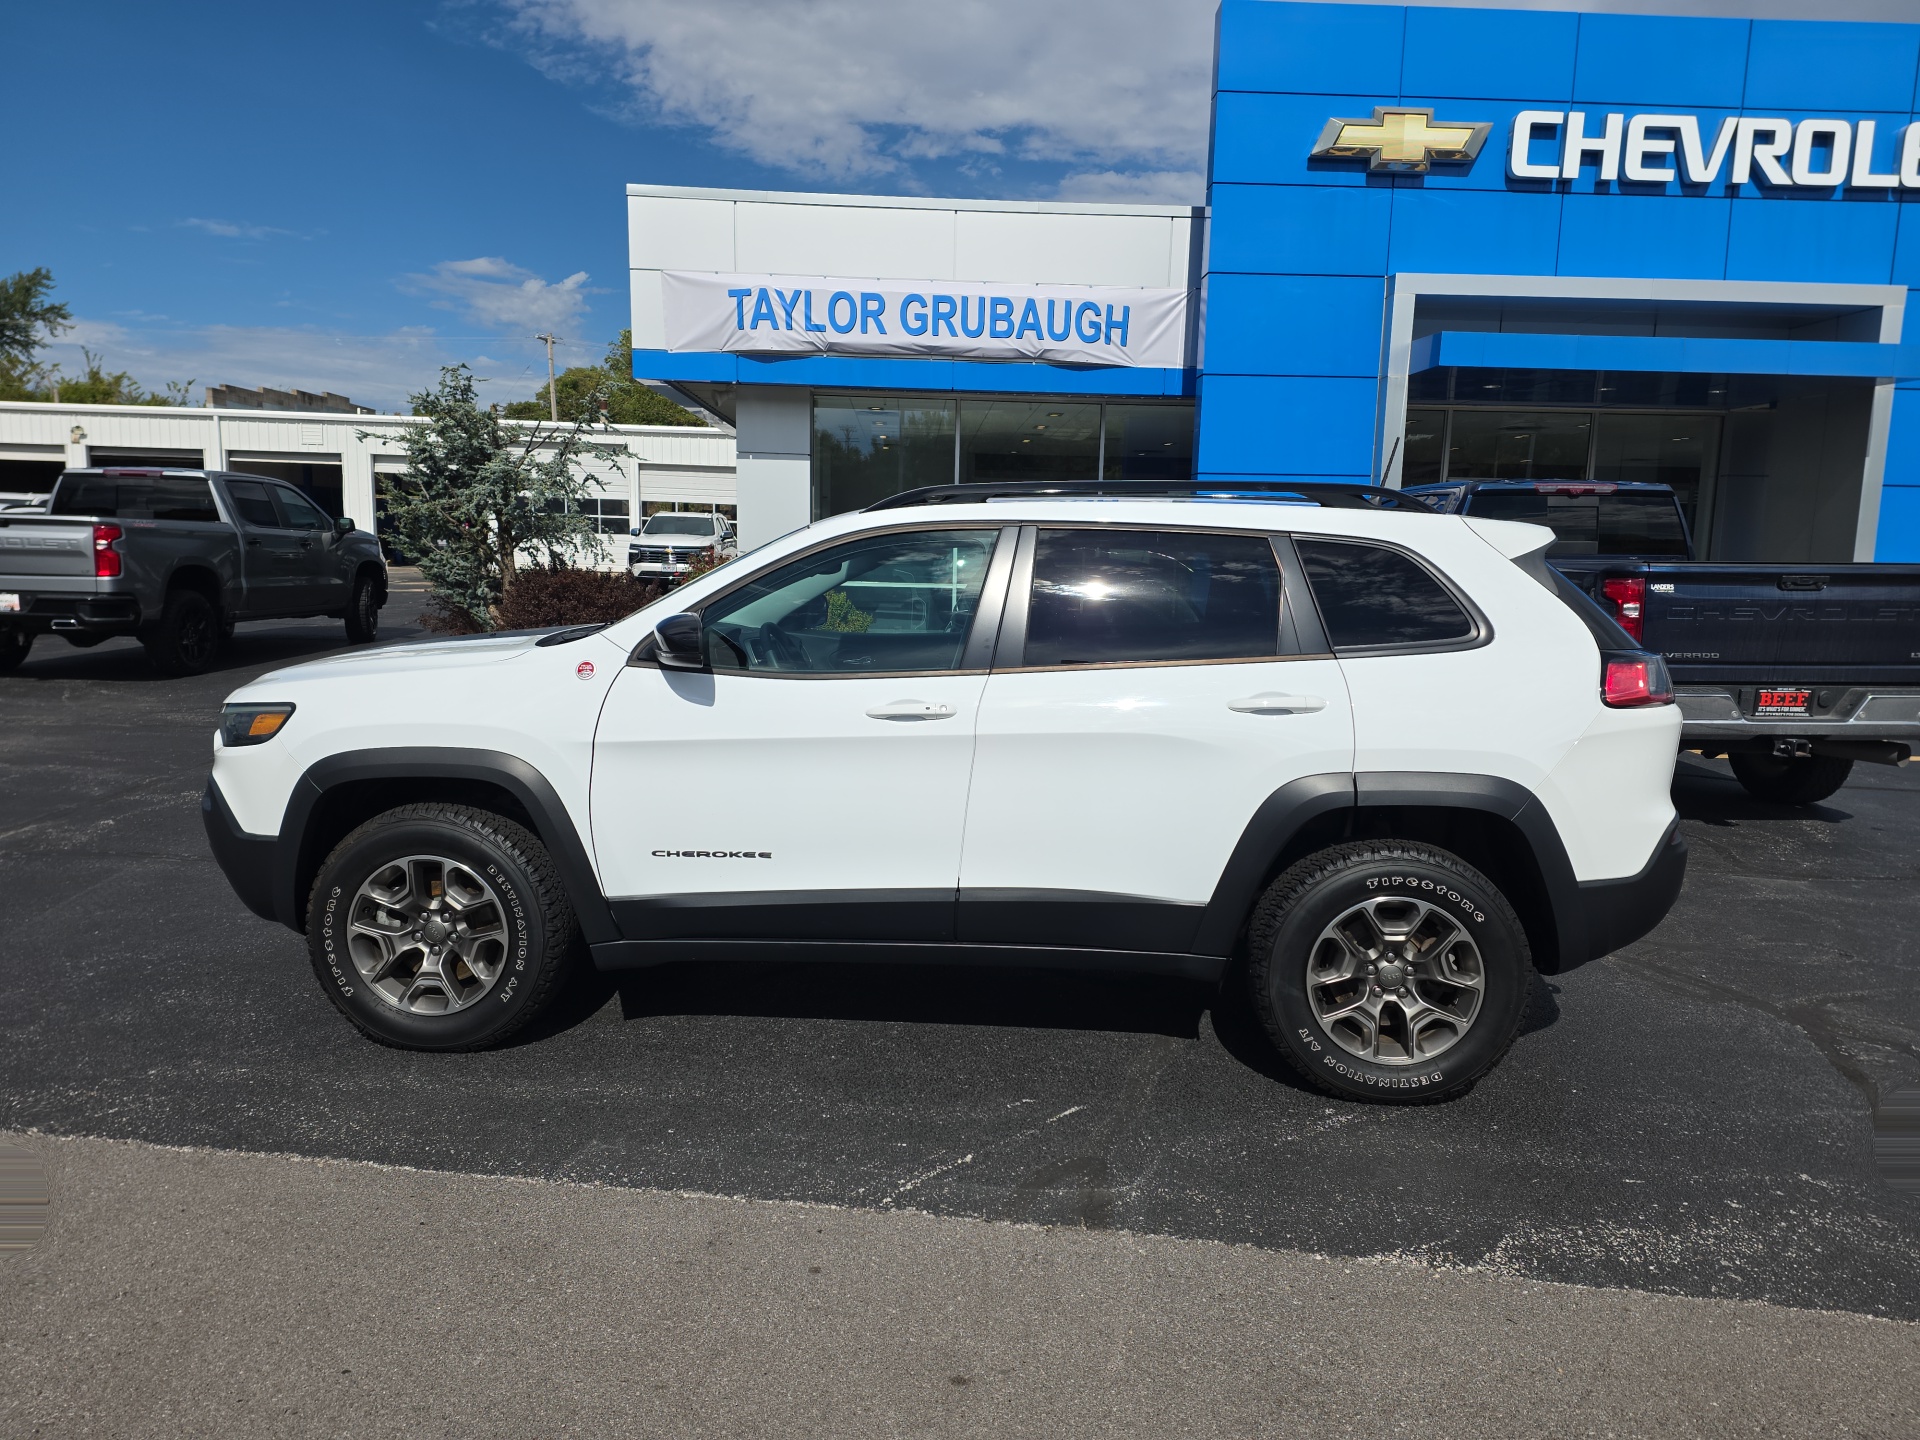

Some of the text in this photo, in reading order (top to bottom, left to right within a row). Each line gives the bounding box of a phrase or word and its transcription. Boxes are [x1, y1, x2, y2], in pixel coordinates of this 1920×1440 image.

[728, 287, 1131, 347] TAYLOR GRUBAUGH
[0, 537, 78, 549] OLET
[1650, 583, 1675, 591] LANDERS
[651, 850, 772, 860] CHEROKEE
[487, 864, 527, 1003] DESTINATION A/T
[1299, 1028, 1444, 1088] DESTINATION A/T
